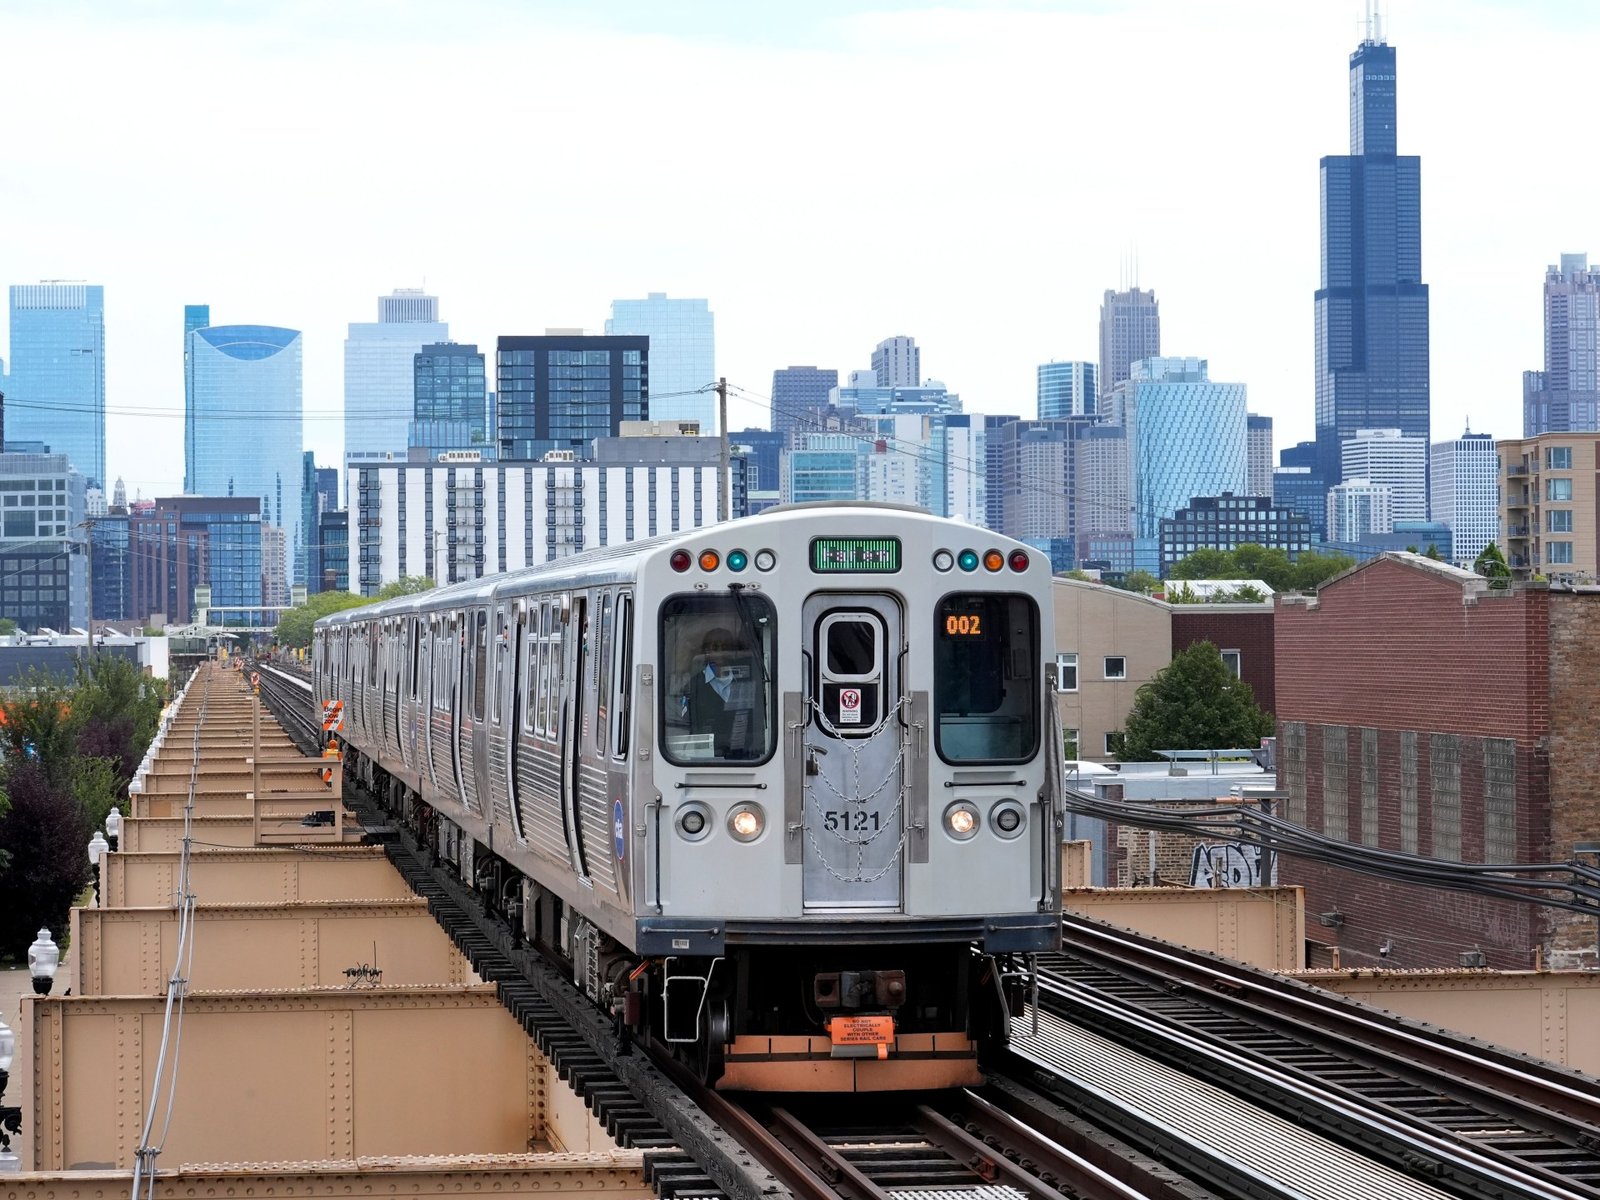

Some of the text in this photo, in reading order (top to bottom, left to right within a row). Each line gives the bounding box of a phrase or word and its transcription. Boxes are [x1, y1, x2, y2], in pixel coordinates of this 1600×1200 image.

[823, 547, 890, 562] Harem
[946, 615, 981, 634] 002
[323, 705, 342, 713] Begin
[824, 811, 879, 830] 5121
